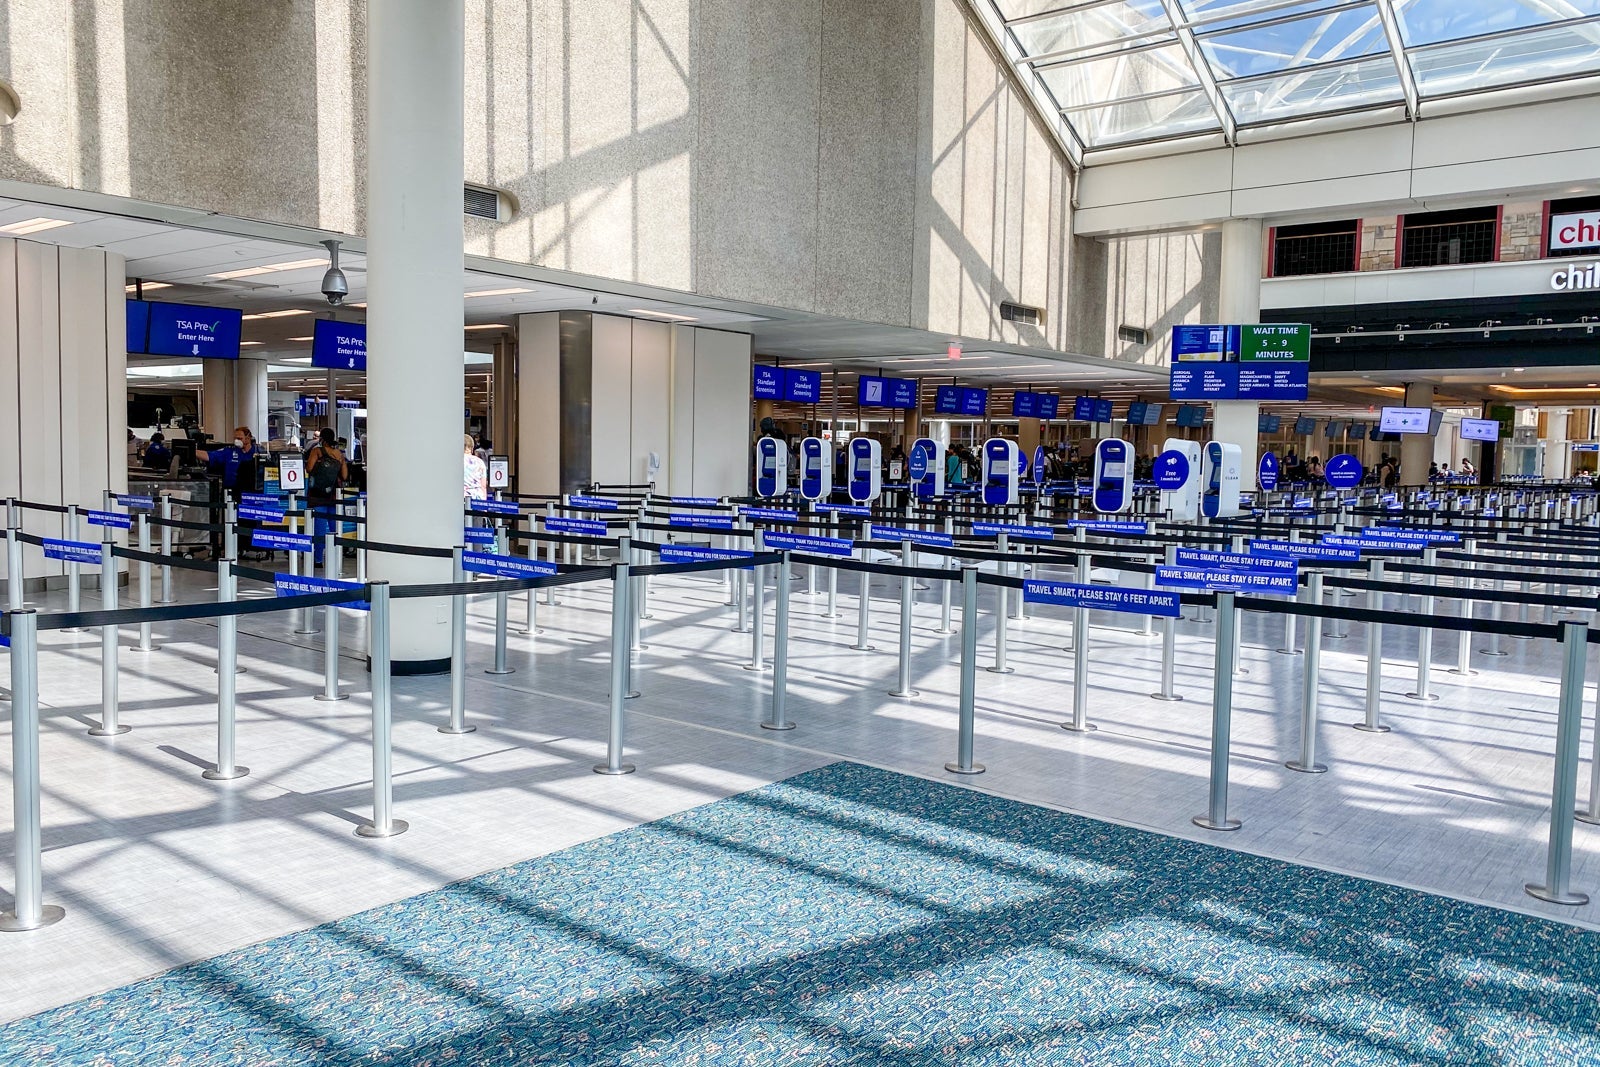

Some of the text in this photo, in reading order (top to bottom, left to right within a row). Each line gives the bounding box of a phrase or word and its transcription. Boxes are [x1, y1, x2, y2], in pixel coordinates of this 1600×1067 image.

[176, 320, 208, 330] TSA Pre
[336, 336, 362, 346] TSA Pre
[756, 386, 775, 394] Screening
[872, 386, 877, 397] 7
[288, 470, 297, 482] 0
[495, 470, 502, 480] 0
[1344, 538, 1359, 547] SMART,
[1271, 544, 1288, 552] SMART,
[1180, 552, 1199, 560] TRAVEL
[1200, 553, 1218, 563] SMART,
[1220, 555, 1240, 564] PLEASE
[1260, 559, 1274, 567] FEET
[1274, 560, 1293, 568] APART.
[534, 566, 555, 575] DISTANCING.
[1160, 570, 1182, 578] TRAVEL
[1184, 571, 1205, 581] SMART,
[1206, 573, 1230, 582] PLEASE
[1230, 574, 1247, 583] STAY
[1253, 576, 1269, 584] FEET
[1270, 577, 1292, 586] APART.
[310, 585, 322, 593] THANK
[1028, 584, 1174, 606] TRAVEL SMART, PLEASE STAY 6 FEET APART.
